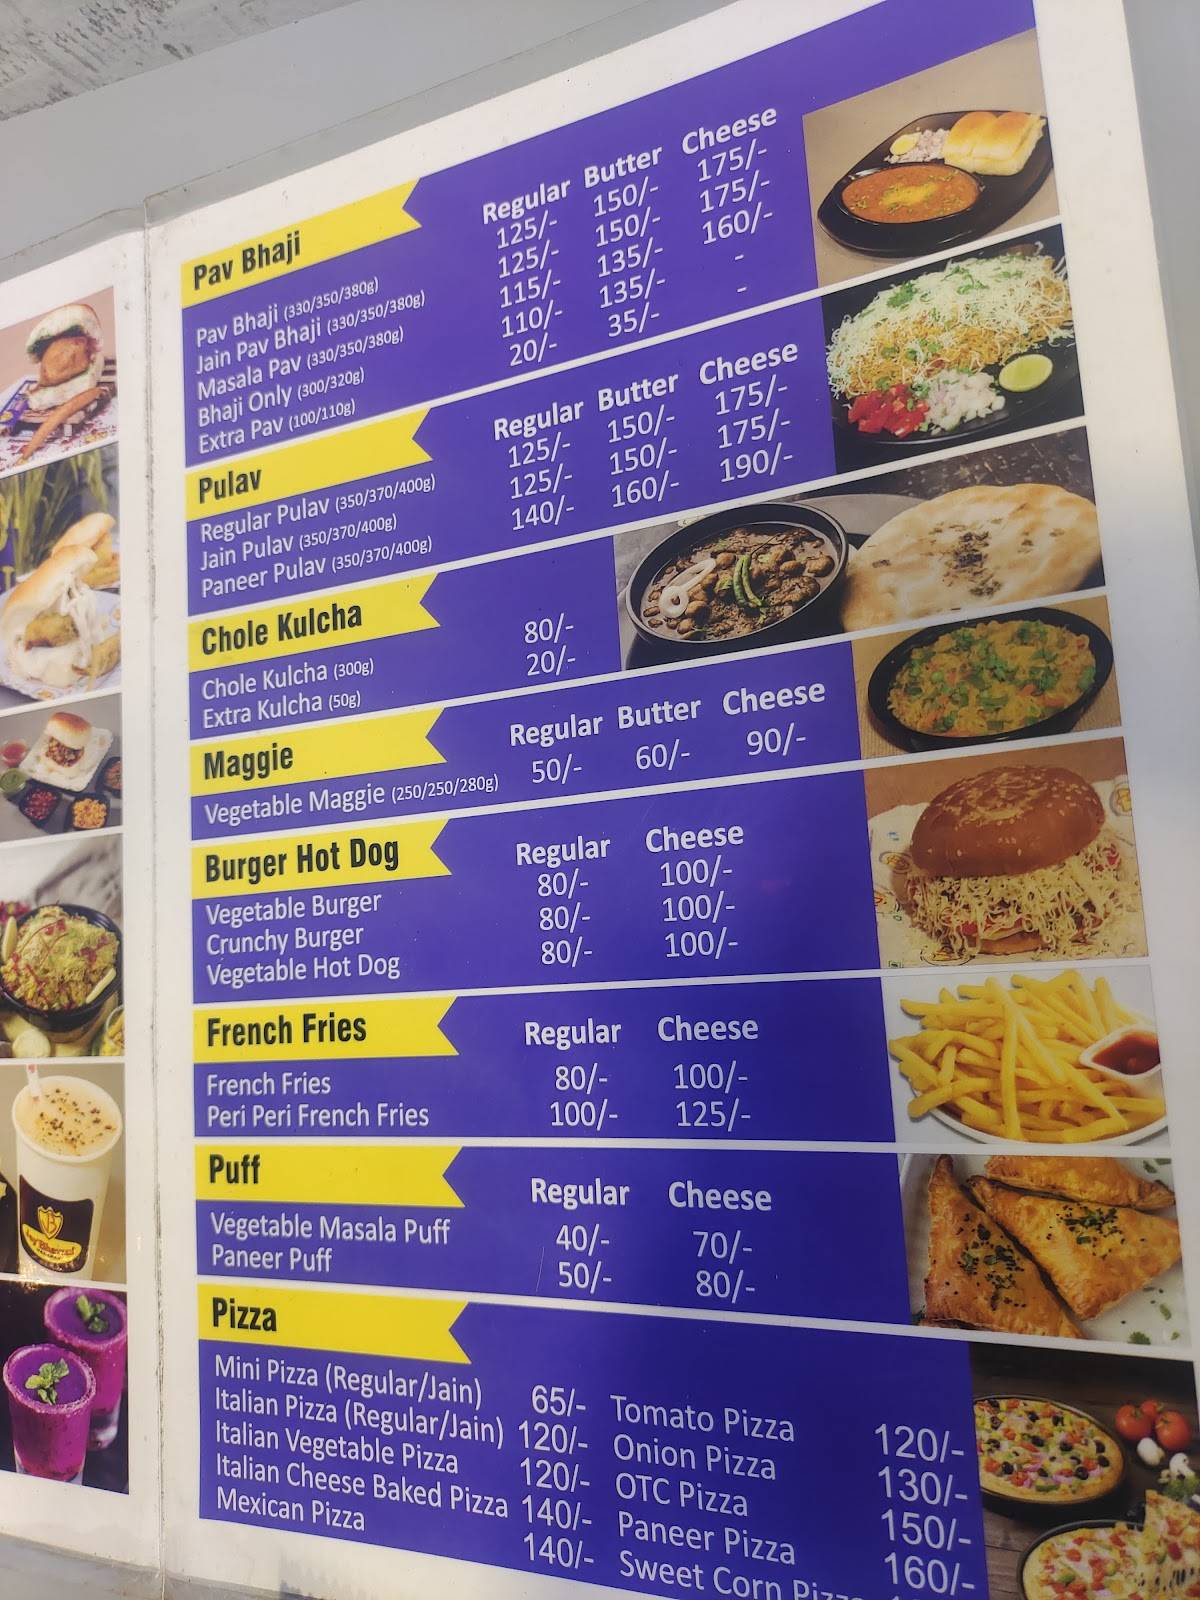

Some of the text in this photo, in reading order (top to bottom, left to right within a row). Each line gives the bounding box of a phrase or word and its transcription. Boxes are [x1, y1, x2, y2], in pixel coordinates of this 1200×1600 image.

[682, 108, 776, 154] Cheese
[584, 147, 662, 188] Butter
[698, 138, 767, 182] 175/-
[483, 180, 570, 224] Regular
[594, 176, 658, 217] 150/-
[700, 169, 770, 213] 175/-
[497, 209, 557, 249] 125/-
[596, 206, 660, 247] 150/-
[702, 201, 773, 244] 160/-
[194, 231, 300, 290] Pav Bhaji
[498, 239, 559, 279] 125/-
[598, 236, 663, 278] 135/-
[500, 269, 561, 308] 115/-
[600, 268, 665, 308] 135/-
[197, 276, 378, 347] Pav Bhaji (330/350/380g)
[502, 299, 563, 338] 110/-
[608, 301, 660, 337] 35/-
[196, 289, 425, 374] Jain Pav Bhaji (330/350/380g)
[510, 332, 557, 366] 20/-
[198, 325, 403, 400] Masala Pav (330/350/380g)
[700, 344, 798, 384] Cheese
[199, 366, 364, 427] Bhaji Only (300/320g)
[598, 374, 679, 411] Butter
[715, 374, 788, 415] 175/-
[199, 398, 355, 454] Extra Pav (100/110g)
[494, 401, 584, 440] Regular
[608, 404, 675, 443] 150/-
[718, 408, 790, 449] 175/-
[508, 431, 570, 468] 125/-
[610, 437, 677, 475] 150/-
[720, 442, 793, 482] 190/-
[199, 470, 261, 504] Pulav
[510, 463, 572, 499] 125/-
[612, 470, 679, 507] 160/-
[201, 473, 435, 543] Regular Pulav (350/370/400g)
[512, 495, 574, 530] 140/-
[200, 513, 397, 571] Jain Pulav (350/370/400g)
[202, 535, 432, 598] Paneer Pulav (350/370/400g)
[202, 603, 362, 655] Chole Kulcha
[525, 613, 574, 643] 80/-
[202, 658, 374, 700] Chole Kulcha (300g)
[527, 645, 576, 676] 20/-
[203, 690, 361, 728] Extra Kulcha (50g)
[618, 700, 701, 729] Butter
[723, 683, 825, 715] Cheese
[510, 714, 603, 747] Regular
[747, 722, 806, 756] 90/-
[204, 743, 293, 781] Maggie
[532, 753, 582, 784] 50/-
[636, 739, 690, 770] 60/-
[204, 773, 498, 826] Vegetable Maggie (250/250/280g)
[516, 835, 611, 868] Regular
[646, 826, 744, 852] Cheese
[206, 838, 398, 885] Burger Hot Dog
[661, 855, 732, 887] 100/-
[538, 868, 588, 899] 80/-
[206, 894, 382, 928] Vegetable Burger
[540, 902, 590, 933] 80/-
[663, 891, 735, 923] 100/-
[207, 927, 364, 960] Crunchy Burger
[542, 936, 592, 967] 80/-
[665, 927, 738, 959] 100/-
[206, 954, 400, 989] Vegetable Hot Dog
[208, 1012, 366, 1046] French Fries
[525, 1018, 621, 1050] Regular
[658, 1015, 758, 1041] Cheese
[207, 1072, 331, 1096] French Fries
[556, 1063, 607, 1095] 80/-
[674, 1061, 747, 1093] 100/-
[208, 1102, 429, 1127] Peri Peri French Fries
[550, 1099, 618, 1131] 100/-
[676, 1098, 750, 1132] 125/-
[210, 1154, 260, 1184] Puff
[531, 1178, 630, 1210] Regular
[669, 1180, 771, 1211] Cheese
[211, 1211, 450, 1245] Vegetable Masala Puff
[556, 1224, 609, 1256] 40/-
[212, 1244, 332, 1272] Paneer Puff
[693, 1230, 752, 1264] 70/-
[559, 1261, 612, 1294] 50/-
[697, 1270, 755, 1303] 80/-
[213, 1297, 277, 1332] Pizza
[215, 1354, 481, 1411] Mini Pizza (Regular/Jain)
[532, 1385, 586, 1417] 65/-
[216, 1387, 503, 1449] Italian Pizza (Regular/Jain)
[610, 1395, 794, 1441] Tomato Pizza
[216, 1420, 458, 1474] Italian Vegetable Pizza
[519, 1420, 588, 1454] 120/-
[876, 1424, 964, 1462] 120/-
[520, 1457, 590, 1492] 120/-
[614, 1434, 775, 1480] Onion Pizza
[217, 1453, 508, 1518] Italian Cheese Baked Pizza
[616, 1473, 747, 1516] OTC Pizza
[879, 1466, 967, 1506] 130/-
[218, 1486, 364, 1531] Mexican Pizza
[522, 1495, 592, 1530] 140/-
[619, 1511, 795, 1565] Paneer Pizza
[882, 1509, 971, 1550] 150/-
[524, 1532, 594, 1569] 140/-
[620, 1550, 704, 1590] Sweet
[714, 1567, 781, 1600] Corn
[885, 1552, 974, 1595] 160/-
